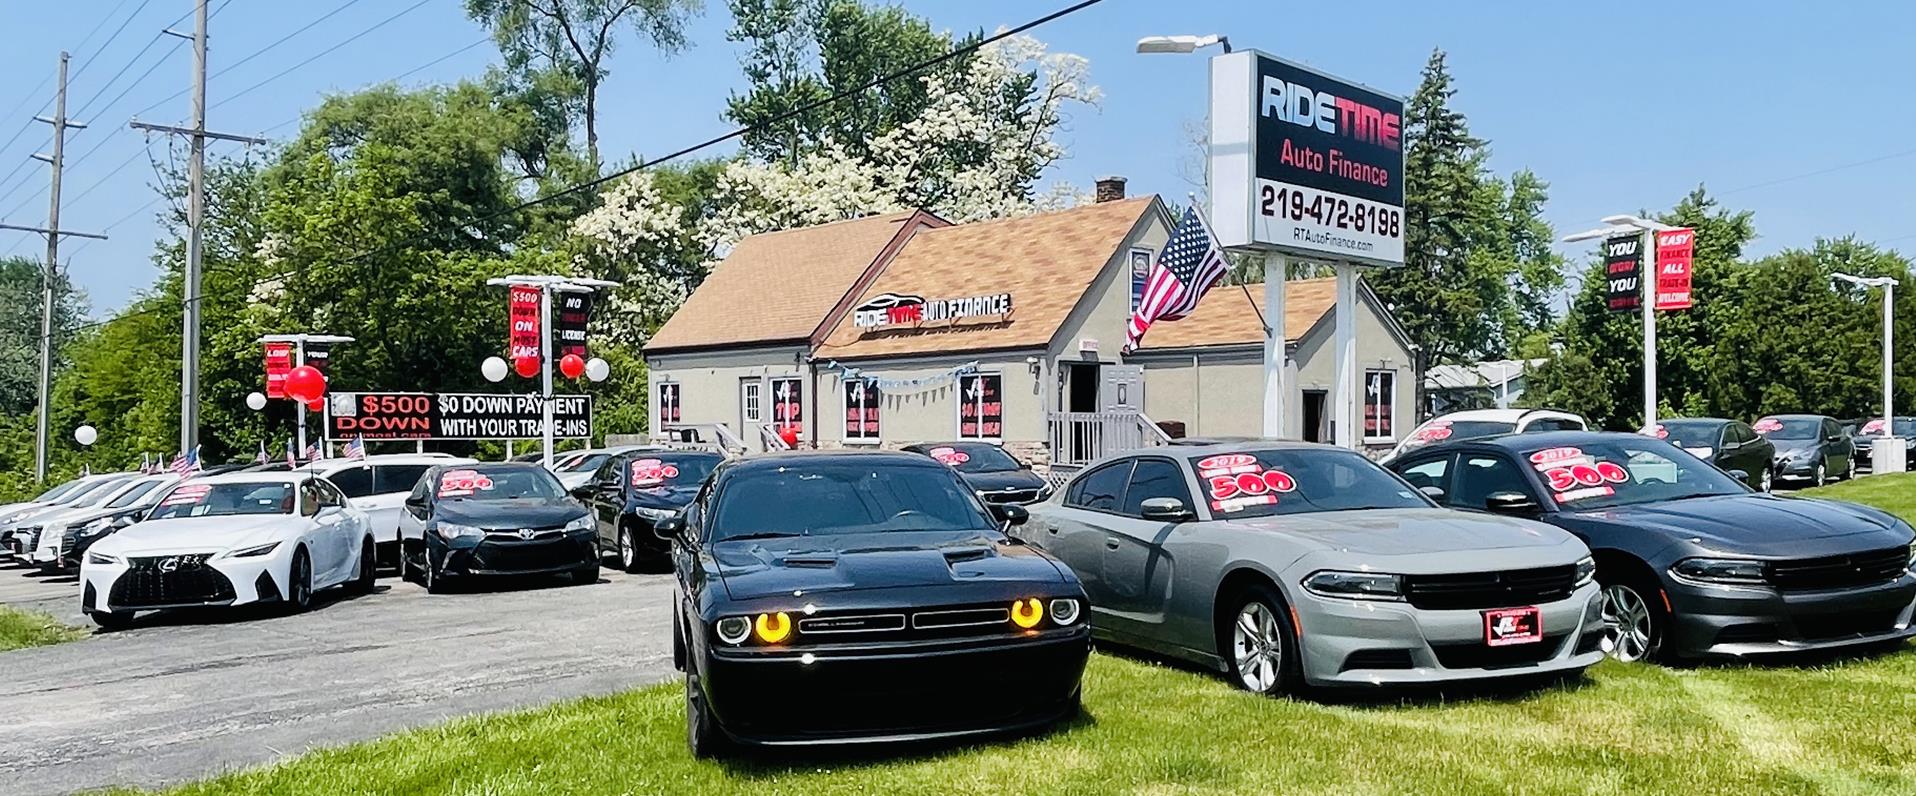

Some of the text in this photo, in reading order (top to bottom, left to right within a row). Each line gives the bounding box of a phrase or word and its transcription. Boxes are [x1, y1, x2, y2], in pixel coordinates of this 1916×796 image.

[1280, 138, 1388, 187] Auto Finance
[1261, 185, 1399, 238] 219-472-8198
[1294, 228, 1373, 252] RTAutoFinance.com
[1660, 234, 1690, 247] EASY
[1609, 241, 1637, 257] YOU
[1663, 263, 1684, 274] ALL
[1609, 278, 1637, 293] YOU
[512, 292, 538, 303] $500
[566, 298, 582, 309] NO
[950, 294, 1010, 318] FINANCE
[515, 321, 533, 331] ON
[512, 346, 538, 357] CARS
[363, 395, 430, 416] $500
[438, 396, 586, 416] $0 DOWN PAYENT
[776, 402, 800, 419] TP
[337, 417, 430, 430] DOWN
[440, 419, 587, 436] WITH YOUR TRAE-INS
[1209, 470, 1297, 500] 500
[1545, 462, 1629, 491] 500
